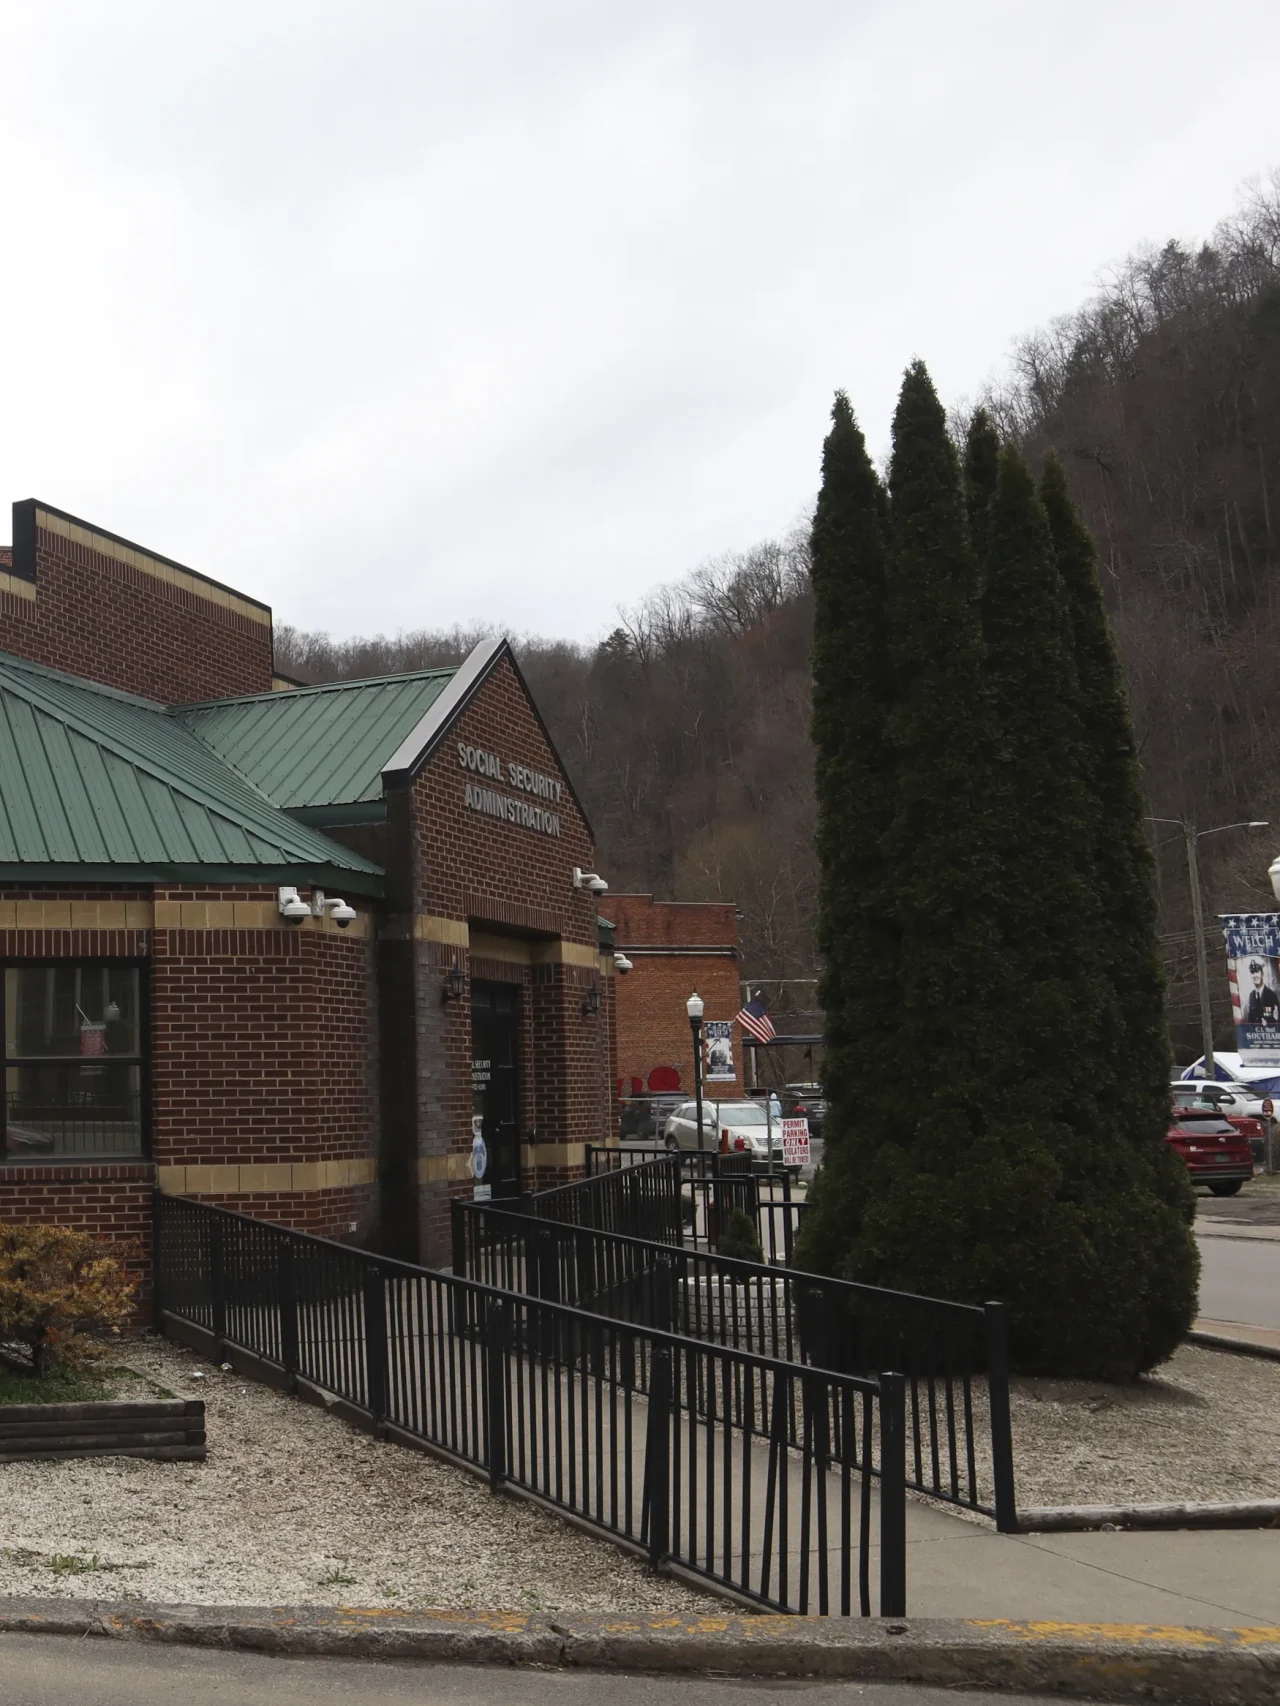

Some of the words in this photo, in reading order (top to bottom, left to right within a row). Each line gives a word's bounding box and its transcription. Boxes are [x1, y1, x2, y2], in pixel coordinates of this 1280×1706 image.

[457, 742, 505, 781] SOCIAL
[508, 763, 561, 803] SECURITY
[464, 783, 560, 838] ADMINISTRATION
[1232, 935, 1275, 947] WELCH
[783, 1120, 805, 1128] PERMIT
[783, 1129, 808, 1137] PARKING
[785, 1138, 807, 1146] ONLY
[784, 1147, 809, 1155] VIOLATORS
